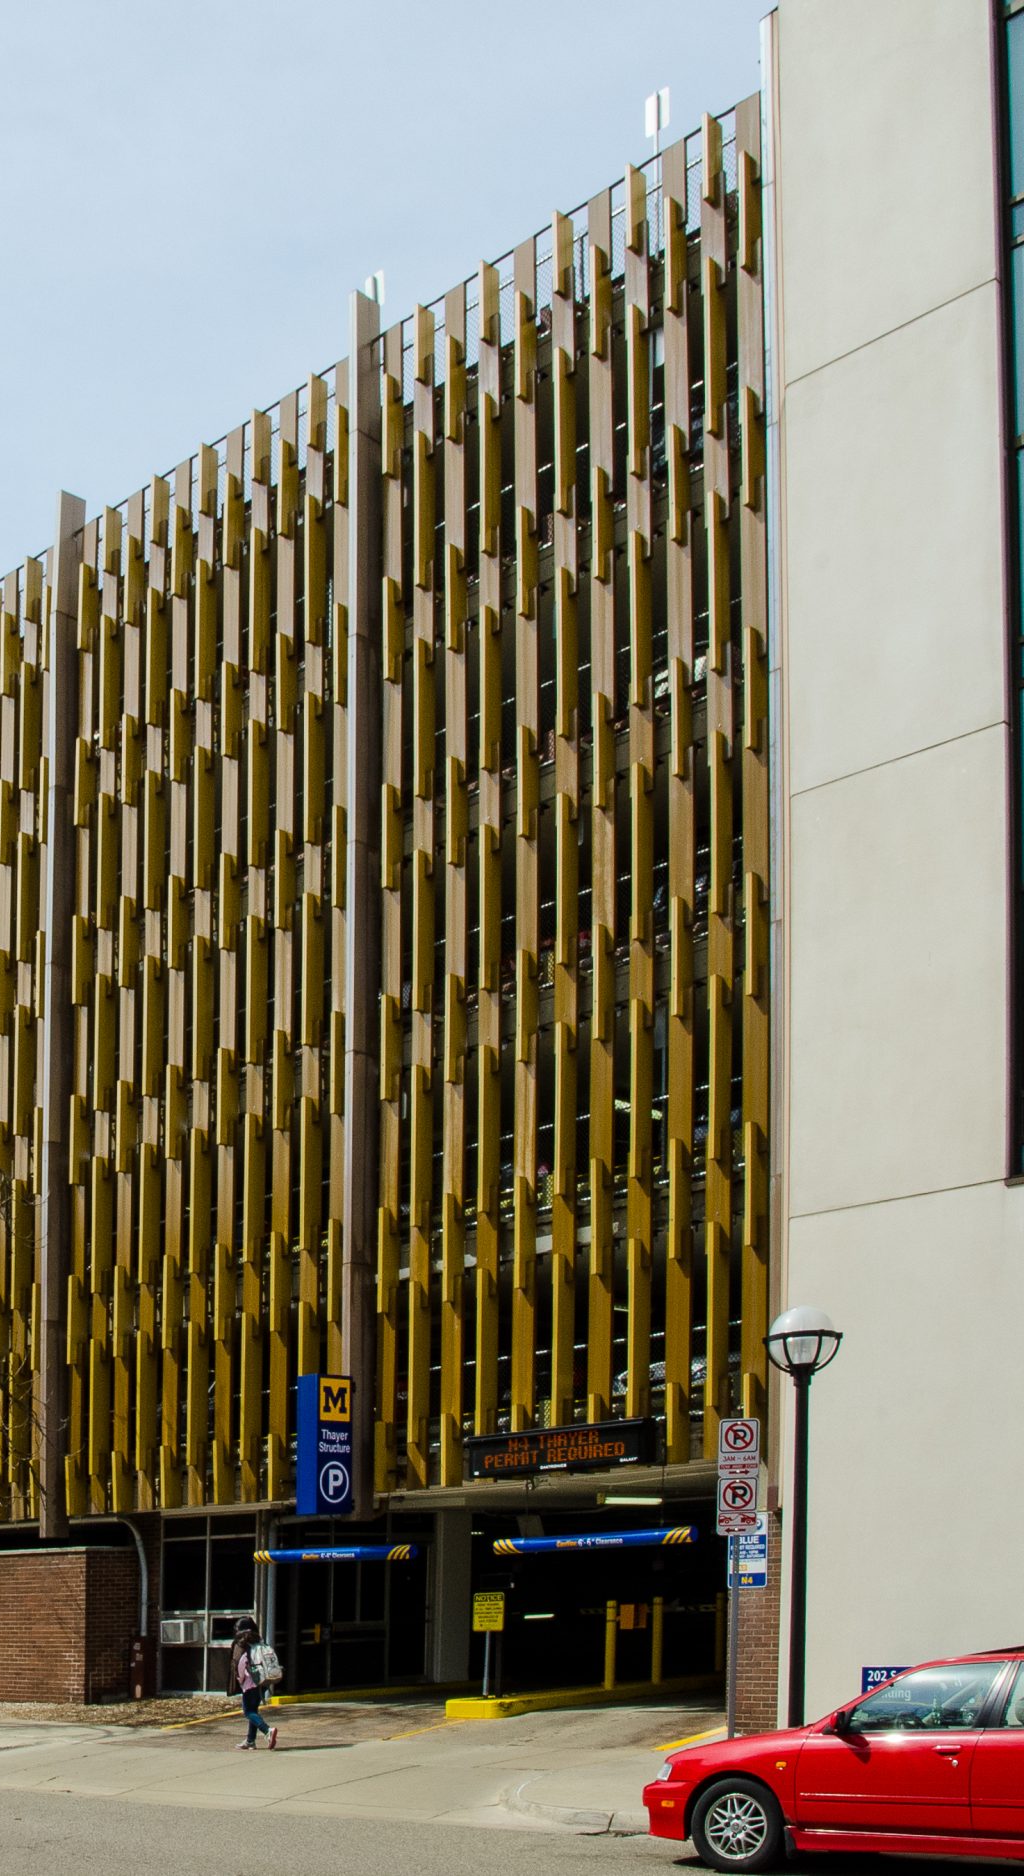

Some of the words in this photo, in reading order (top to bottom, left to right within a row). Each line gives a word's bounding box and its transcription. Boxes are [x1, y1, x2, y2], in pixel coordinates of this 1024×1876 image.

[323, 1386, 347, 1413] M
[321, 1429, 348, 1442] Thayer
[538, 1429, 600, 1449] THAYER
[319, 1442, 350, 1453] Structure
[484, 1451, 538, 1469] PERMIT
[547, 1441, 625, 1463] REQUIRED
[328, 1469, 344, 1496] P
[595, 1537, 623, 1545] Clearance
[867, 1670, 887, 1681] 202
